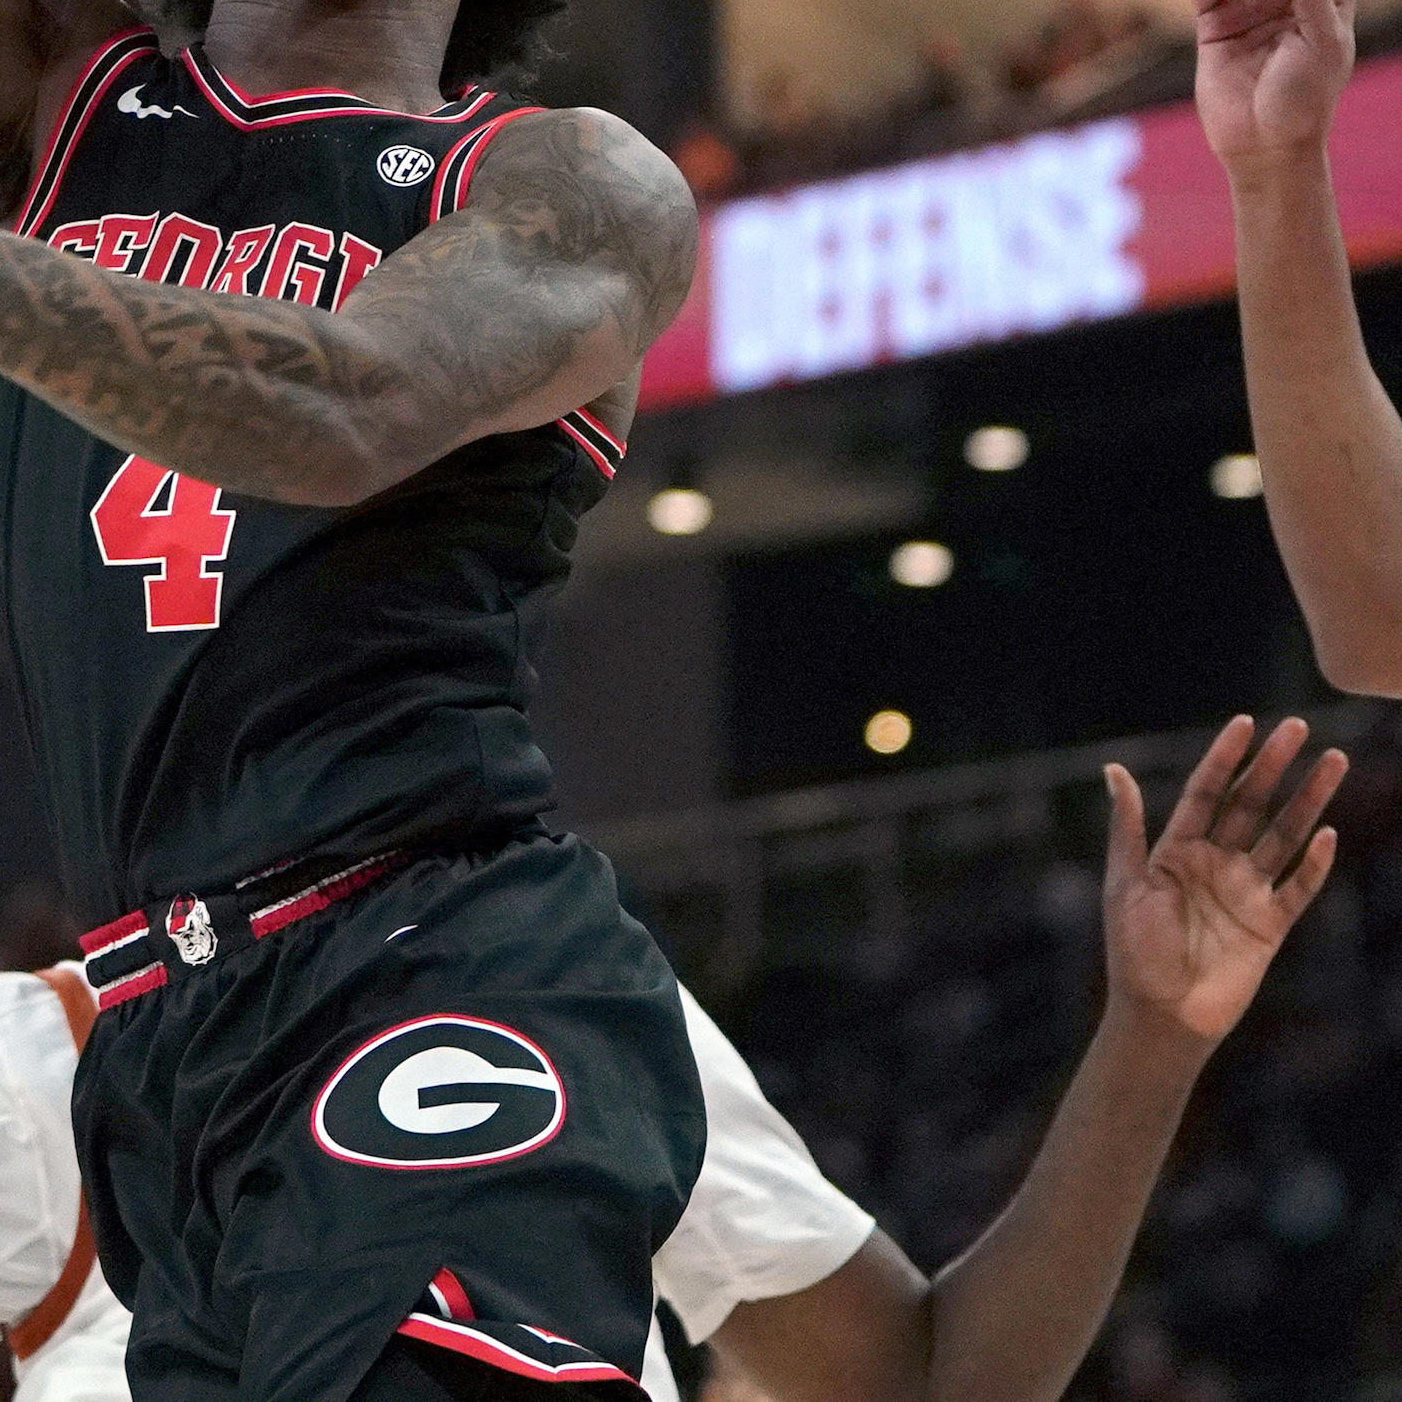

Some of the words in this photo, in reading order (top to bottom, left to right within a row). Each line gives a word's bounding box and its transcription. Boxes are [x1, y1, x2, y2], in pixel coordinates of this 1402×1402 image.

[380, 147, 432, 185] SEC
[48, 210, 383, 314] EORGI
[711, 116, 1144, 394] DEFENSE
[89, 454, 236, 632] 4
